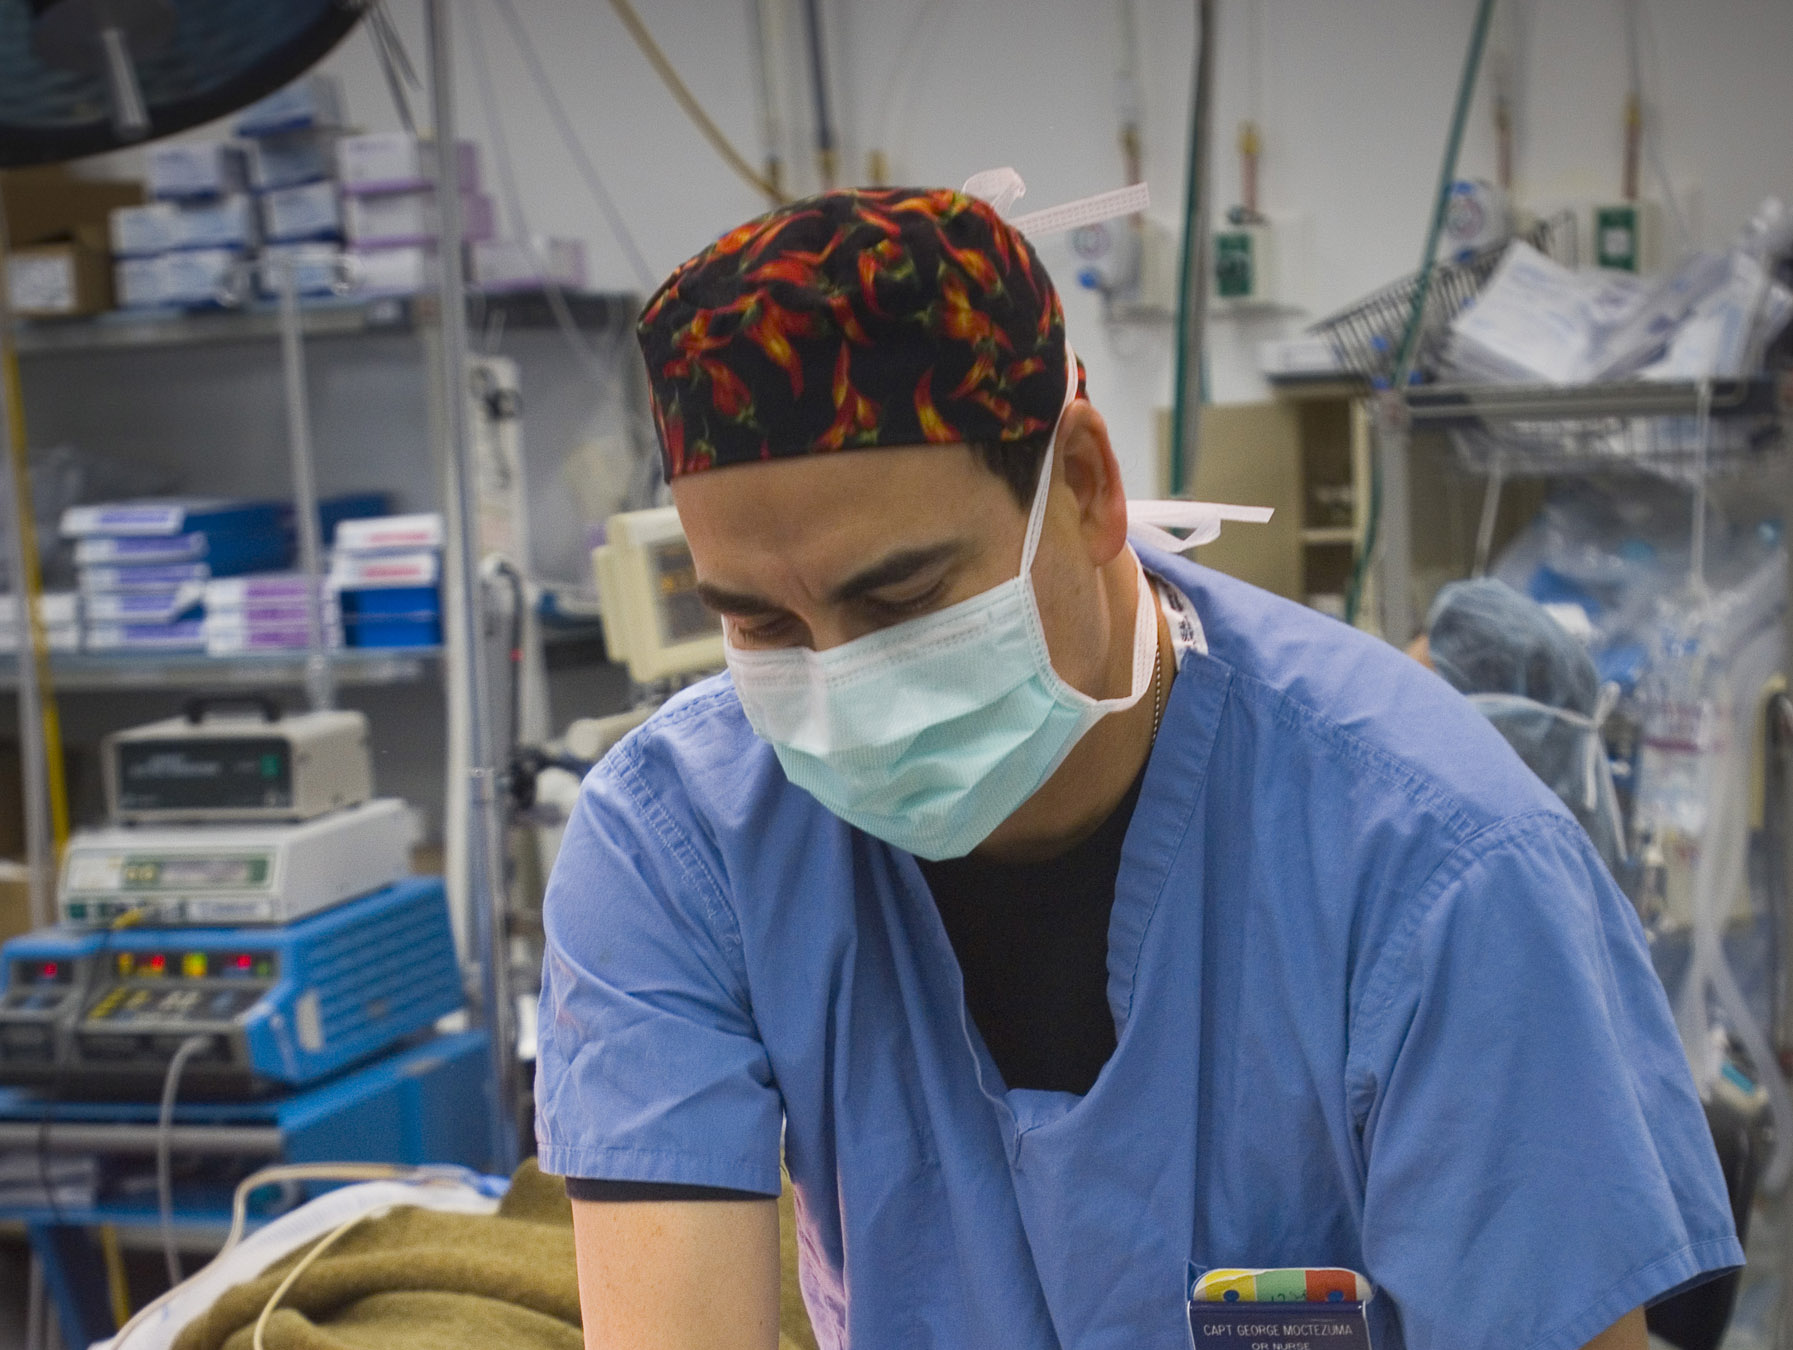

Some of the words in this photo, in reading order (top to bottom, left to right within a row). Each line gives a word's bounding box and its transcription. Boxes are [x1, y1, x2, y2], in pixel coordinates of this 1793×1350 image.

[1203, 1324, 1232, 1336] CAPT
[1237, 1324, 1280, 1336] GEORGE
[1283, 1324, 1353, 1336] MOCTEZUMA
[1251, 1342, 1269, 1350] OR
[1273, 1342, 1311, 1350] NURSE
